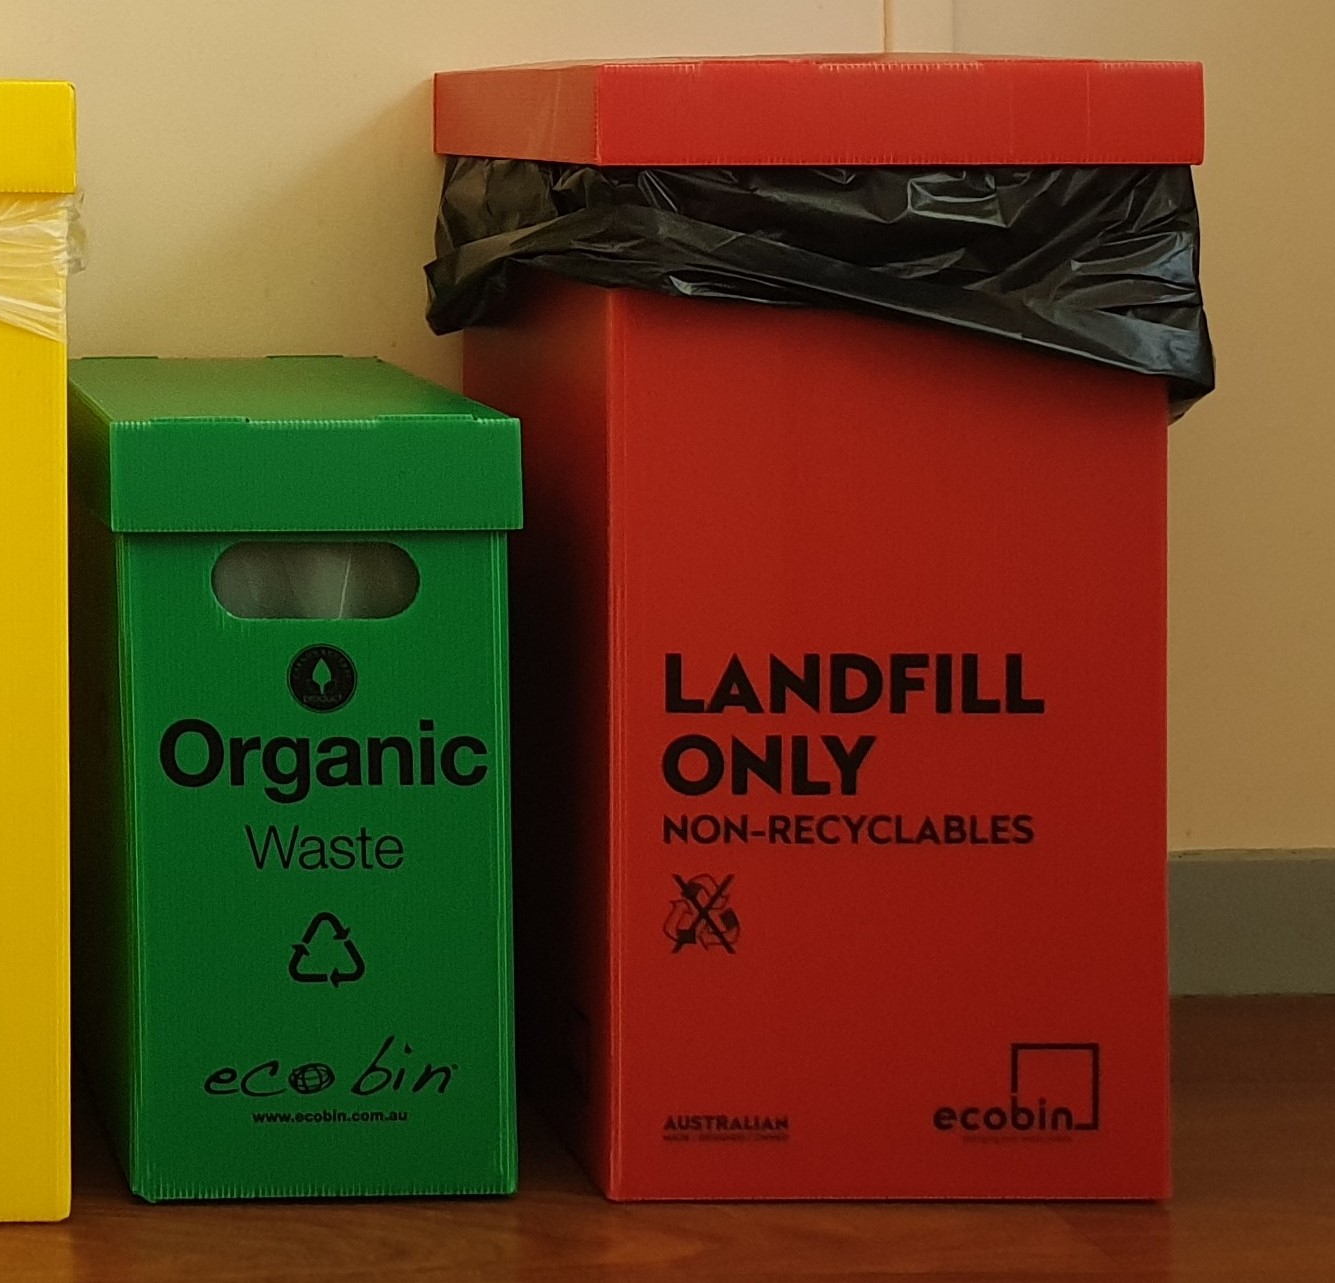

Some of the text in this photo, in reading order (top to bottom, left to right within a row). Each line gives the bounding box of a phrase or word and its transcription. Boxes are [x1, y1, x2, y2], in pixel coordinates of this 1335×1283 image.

[664, 652, 1046, 715] LANDFILL
[158, 717, 490, 805] Organic
[661, 733, 878, 797] ONLY
[243, 823, 406, 871] Waste
[662, 813, 1036, 846] NON-RECYCLABLES
[203, 1034, 454, 1098] eco bin
[251, 1108, 409, 1123] www.ecobin.com.au
[663, 1114, 790, 1131] AUSTRALIAN
[932, 1095, 1075, 1131] ecobin
